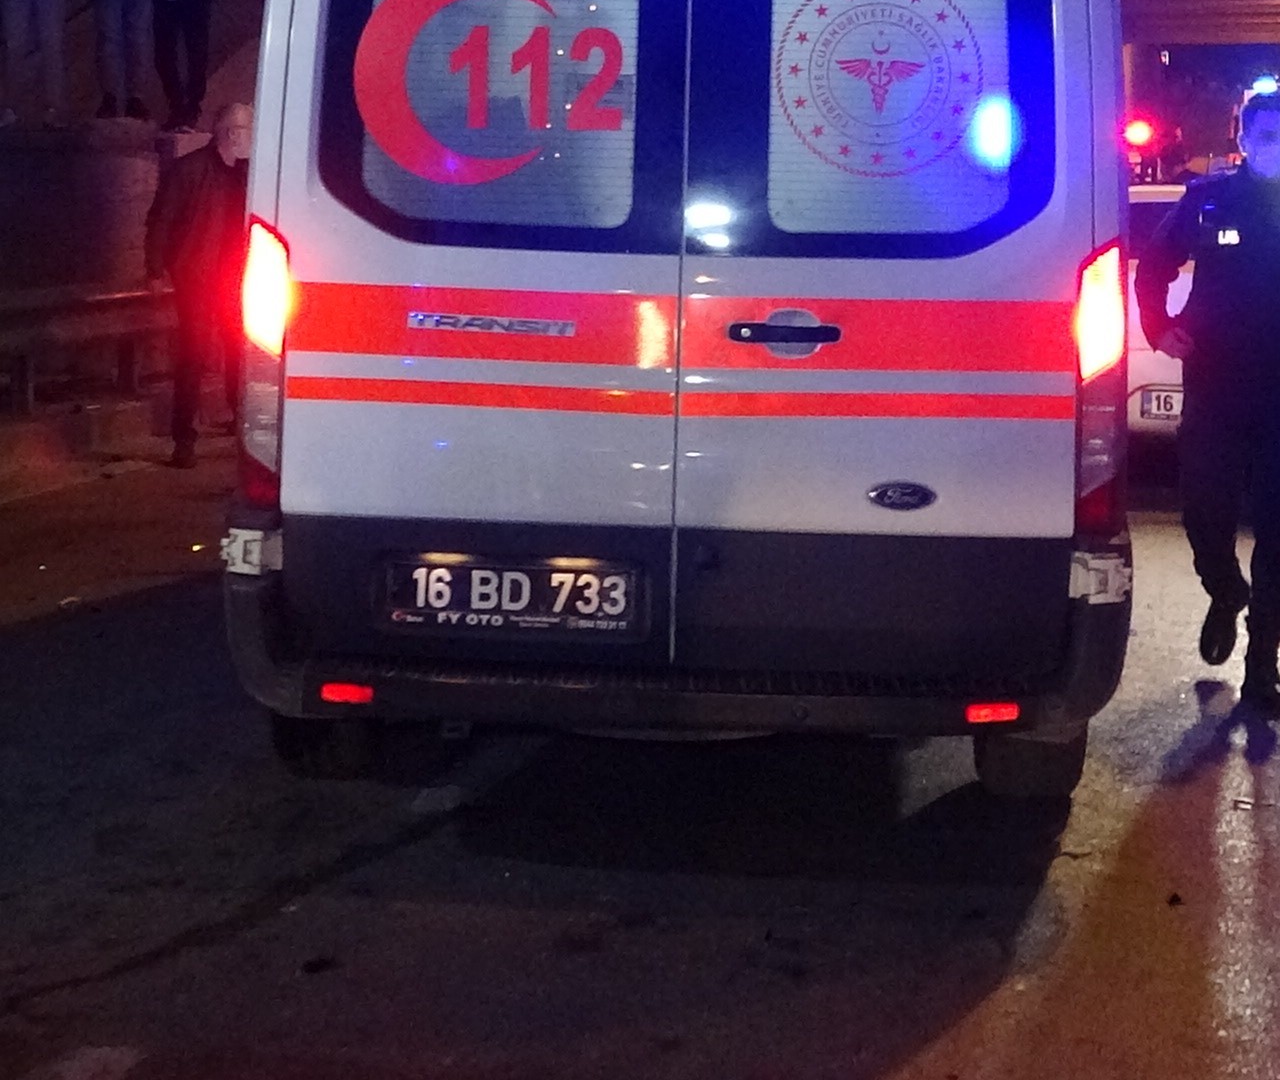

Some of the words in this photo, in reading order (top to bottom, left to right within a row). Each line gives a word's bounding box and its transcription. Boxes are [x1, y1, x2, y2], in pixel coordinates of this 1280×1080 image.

[449, 25, 623, 131] 112
[408, 312, 577, 336] TRANSIT
[1155, 394, 1174, 412] 16
[412, 568, 452, 609] 16
[470, 569, 531, 611] BD
[550, 573, 627, 616] 733
[437, 611, 460, 624] FY
[465, 613, 504, 626] OTO
